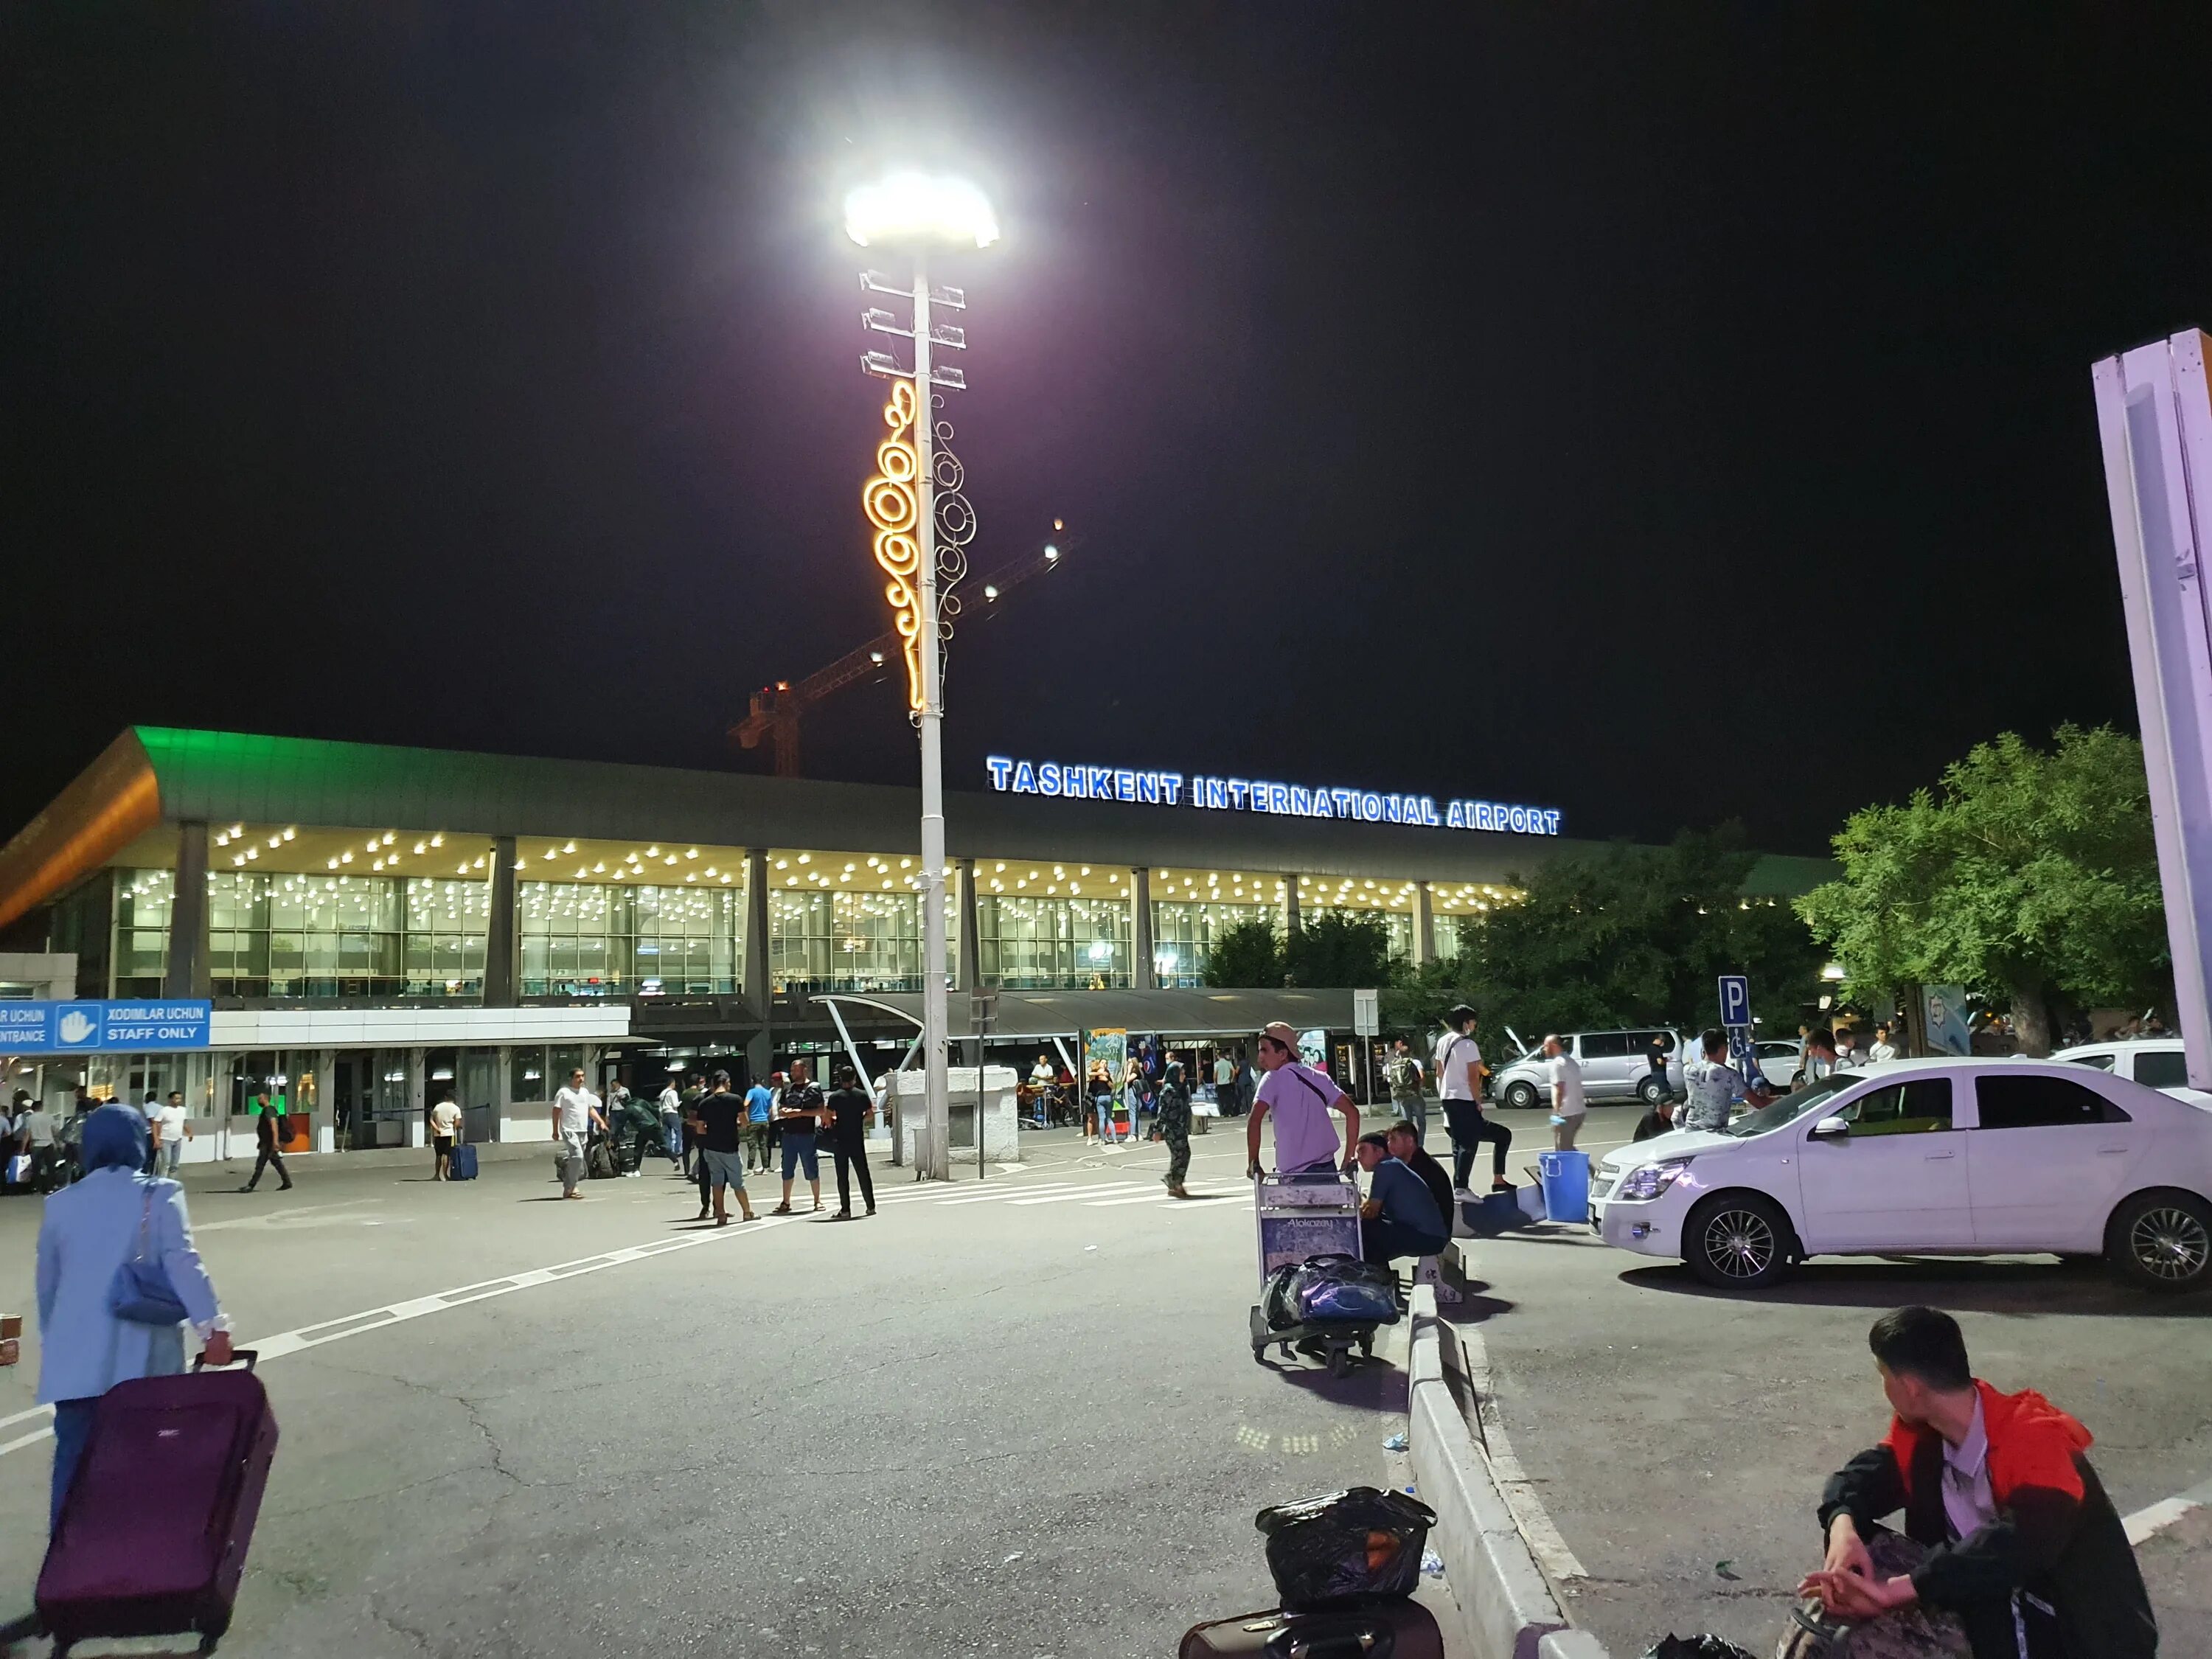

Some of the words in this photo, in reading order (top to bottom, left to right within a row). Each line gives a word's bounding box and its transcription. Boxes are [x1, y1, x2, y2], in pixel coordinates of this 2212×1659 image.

[987, 757, 1181, 805] TASHKENT
[1193, 777, 1439, 827] INTERNATIONAL
[1447, 801, 1560, 835] AIRPORT
[1727, 981, 1743, 1020] P
[10, 1009, 45, 1023] UCHUN
[107, 1008, 164, 1020] XODIMLAR
[167, 1007, 204, 1020] UCHUN
[107, 1028, 155, 1040] STAFF
[158, 1027, 197, 1039] ONLY
